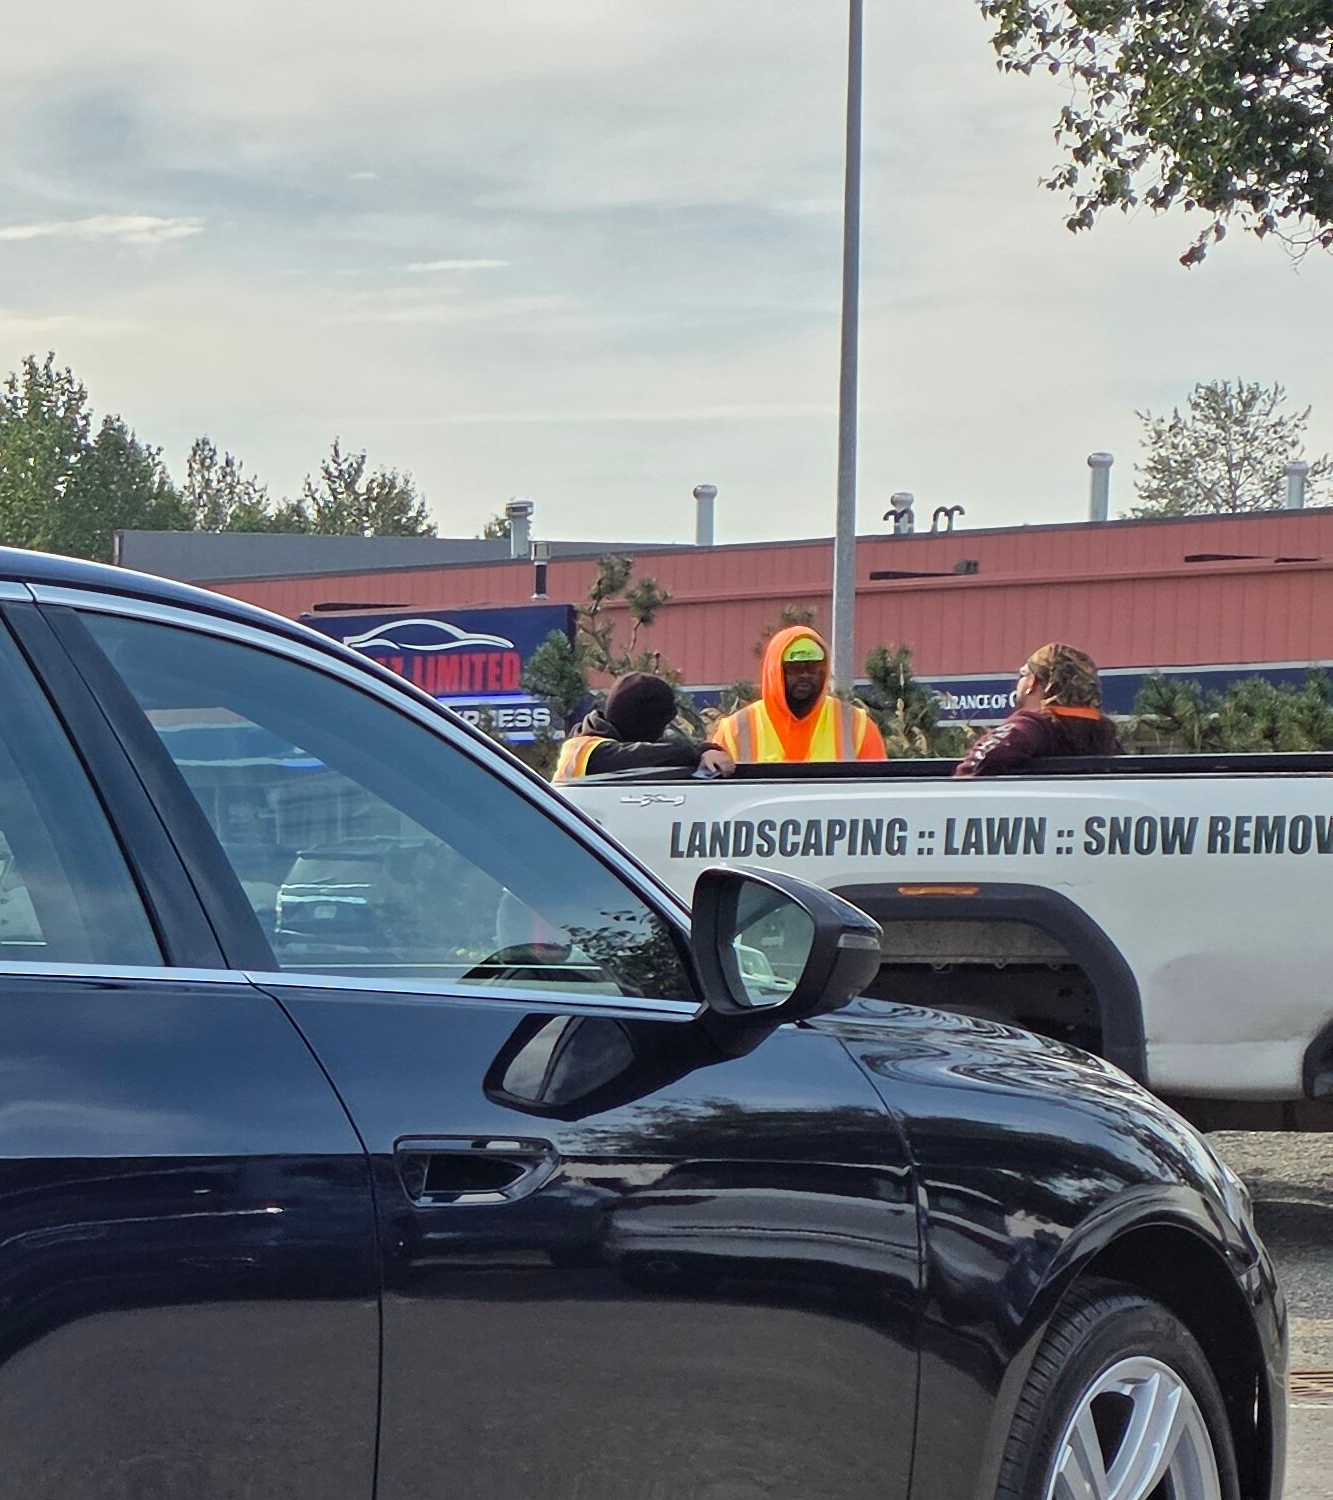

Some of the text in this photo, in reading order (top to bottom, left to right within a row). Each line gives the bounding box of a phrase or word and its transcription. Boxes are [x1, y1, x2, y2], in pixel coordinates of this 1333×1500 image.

[669, 817, 909, 859] LANDSCAPING
[943, 816, 1047, 856] LAWN
[1083, 815, 1199, 856] SNOW
